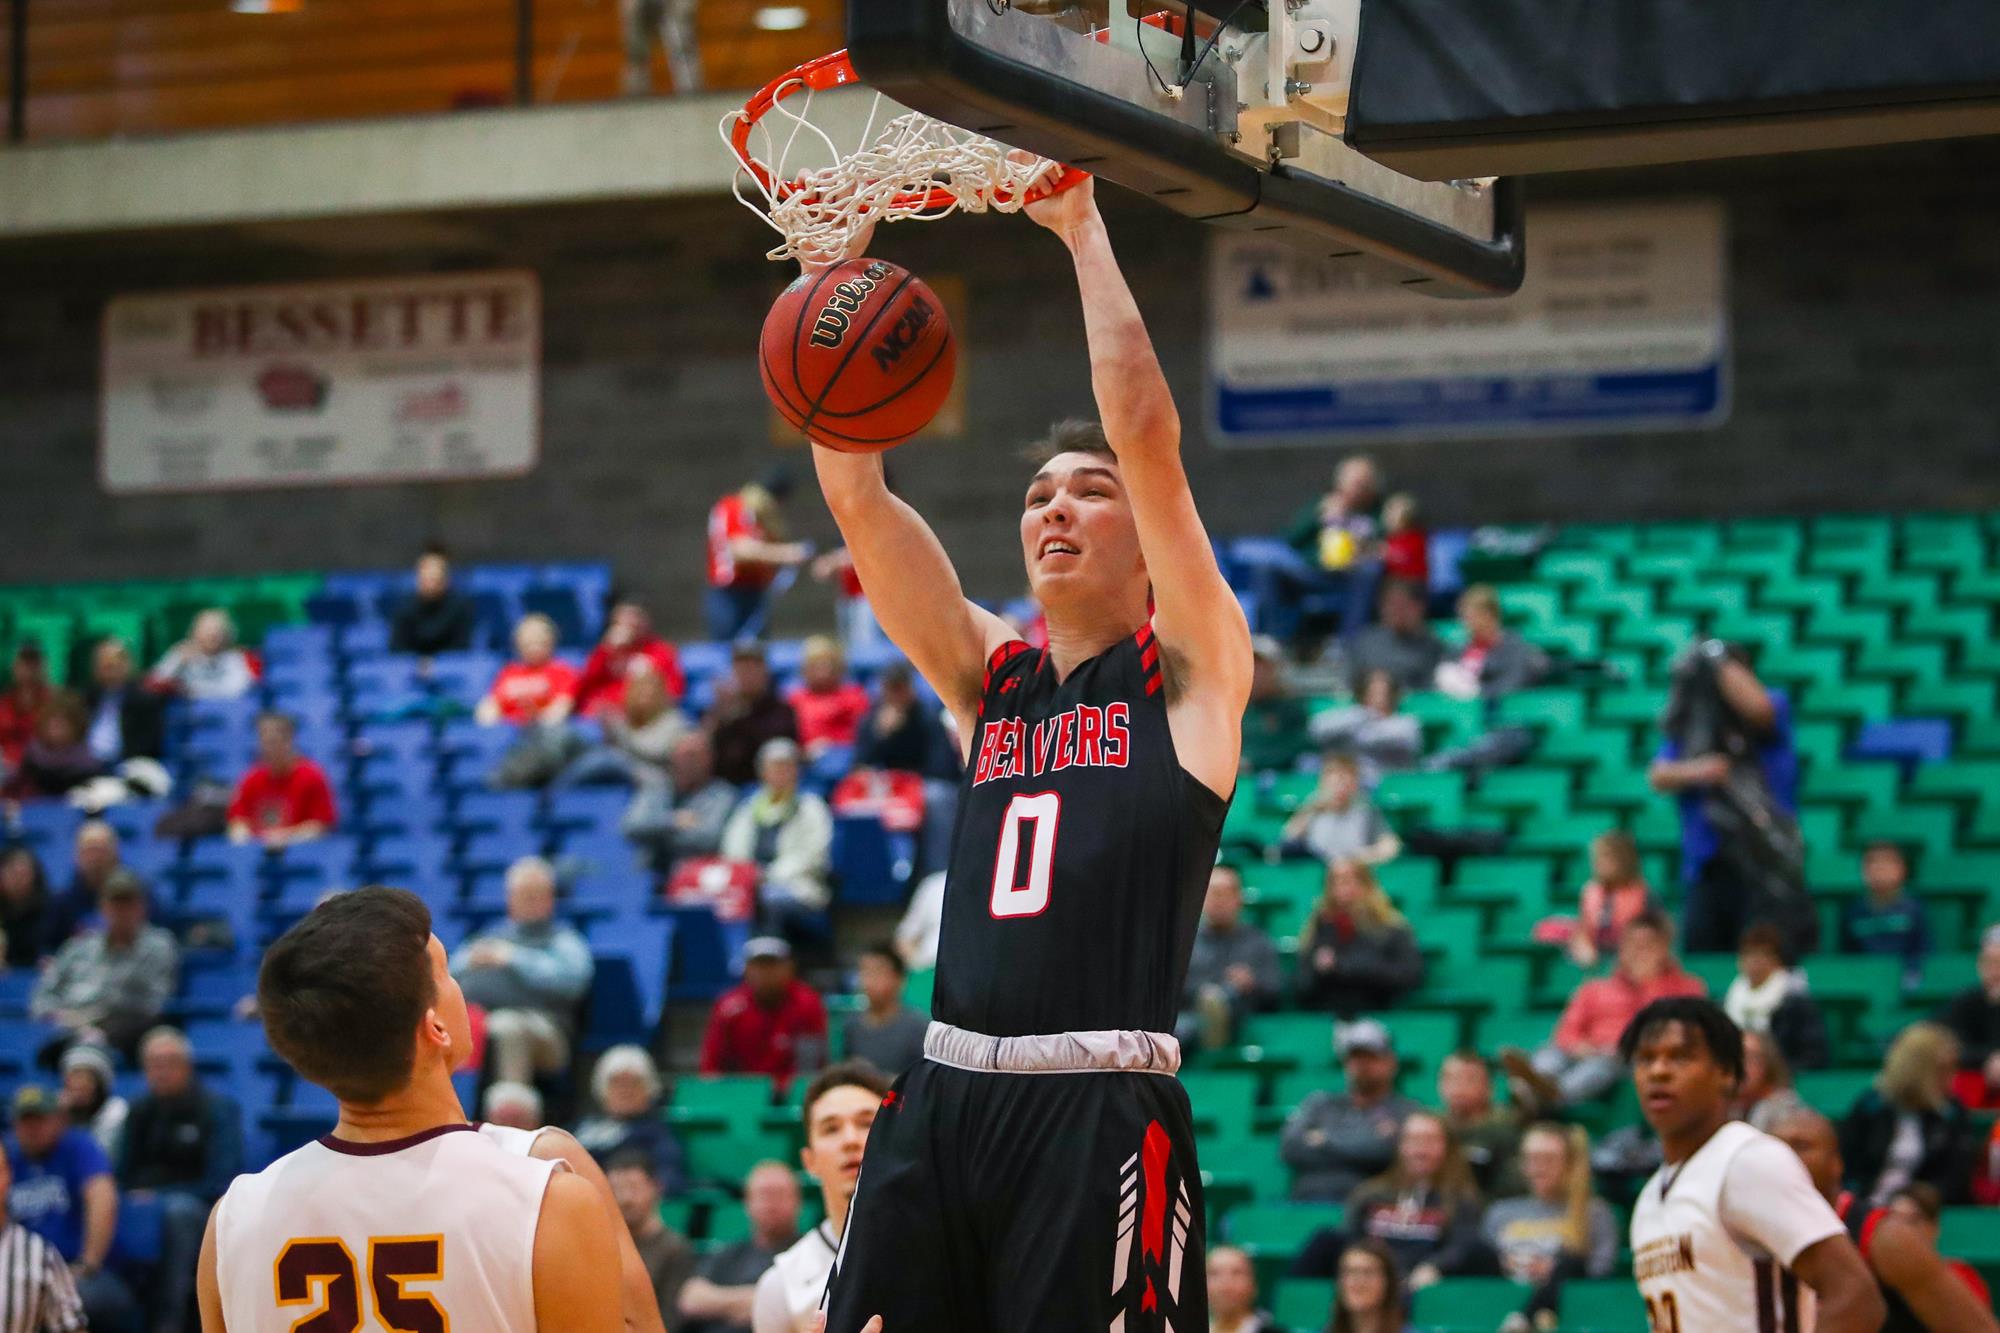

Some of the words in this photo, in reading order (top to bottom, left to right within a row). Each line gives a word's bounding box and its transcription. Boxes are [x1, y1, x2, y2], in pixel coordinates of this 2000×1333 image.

[193, 288, 519, 357] BESSETTE
[874, 297, 934, 373] NCAA
[973, 701, 1130, 787] BEAVERS
[988, 790, 1062, 920] 0
[273, 1233, 451, 1333] 25
